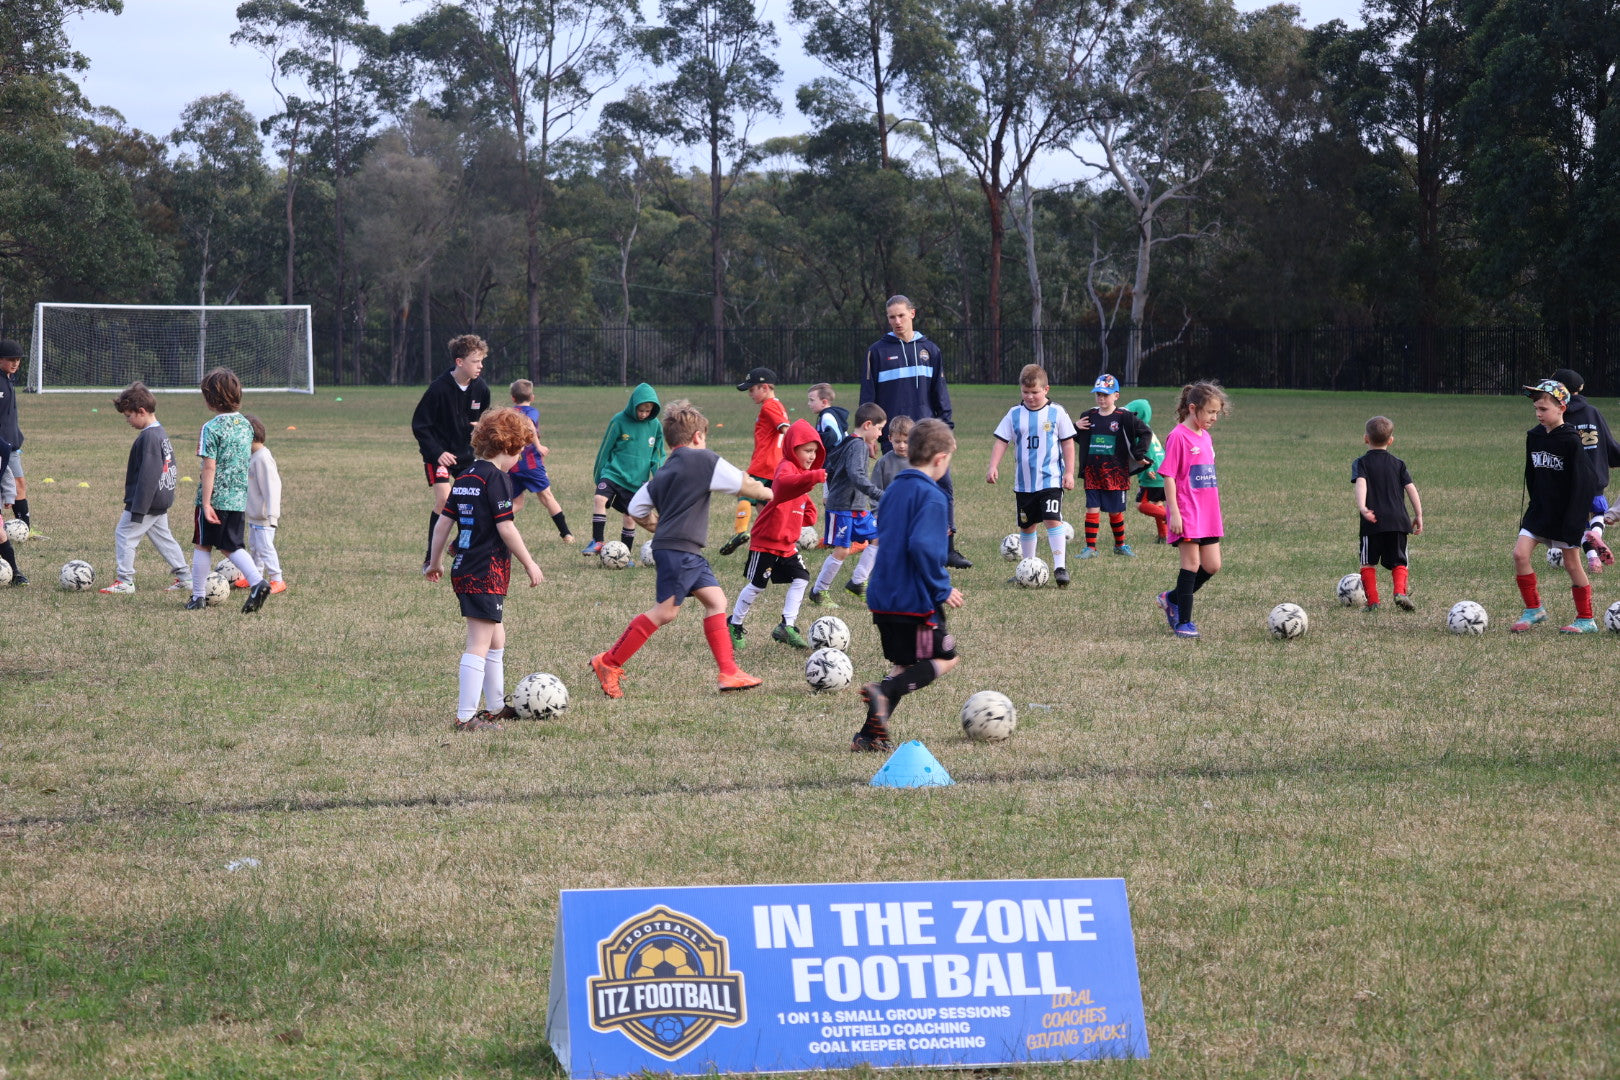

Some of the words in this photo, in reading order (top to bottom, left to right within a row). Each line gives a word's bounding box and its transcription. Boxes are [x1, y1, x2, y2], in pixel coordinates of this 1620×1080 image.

[1027, 436, 1039, 449] 10
[1046, 499, 1059, 513] 10
[626, 922, 698, 945] FOOTBALL
[753, 905, 814, 949] IN
[830, 901, 937, 947] THE
[952, 898, 1097, 944] ZONE
[791, 951, 1072, 1003] FOOTBALL
[598, 987, 631, 1018] ITZ
[634, 983, 737, 1014] FOOTBALL
[1052, 989, 1095, 1009] LOCAL
[777, 1012, 786, 1025] 1
[788, 1011, 810, 1025] ON
[811, 1011, 820, 1024] 1
[822, 1010, 834, 1024] &
[835, 1009, 884, 1023] SMALL
[885, 1007, 937, 1022] GROUP
[939, 1005, 1011, 1020] SESSIONS
[1042, 1007, 1107, 1029] COACHES
[821, 1023, 892, 1038] OUTFIELD
[893, 1021, 970, 1036] COACHING
[1025, 1030, 1079, 1051] GIVING
[1082, 1023, 1127, 1045] BACK!
[808, 1040, 850, 1054] GOAL
[851, 1038, 906, 1053] KEEPER
[908, 1036, 986, 1051] COACHING
